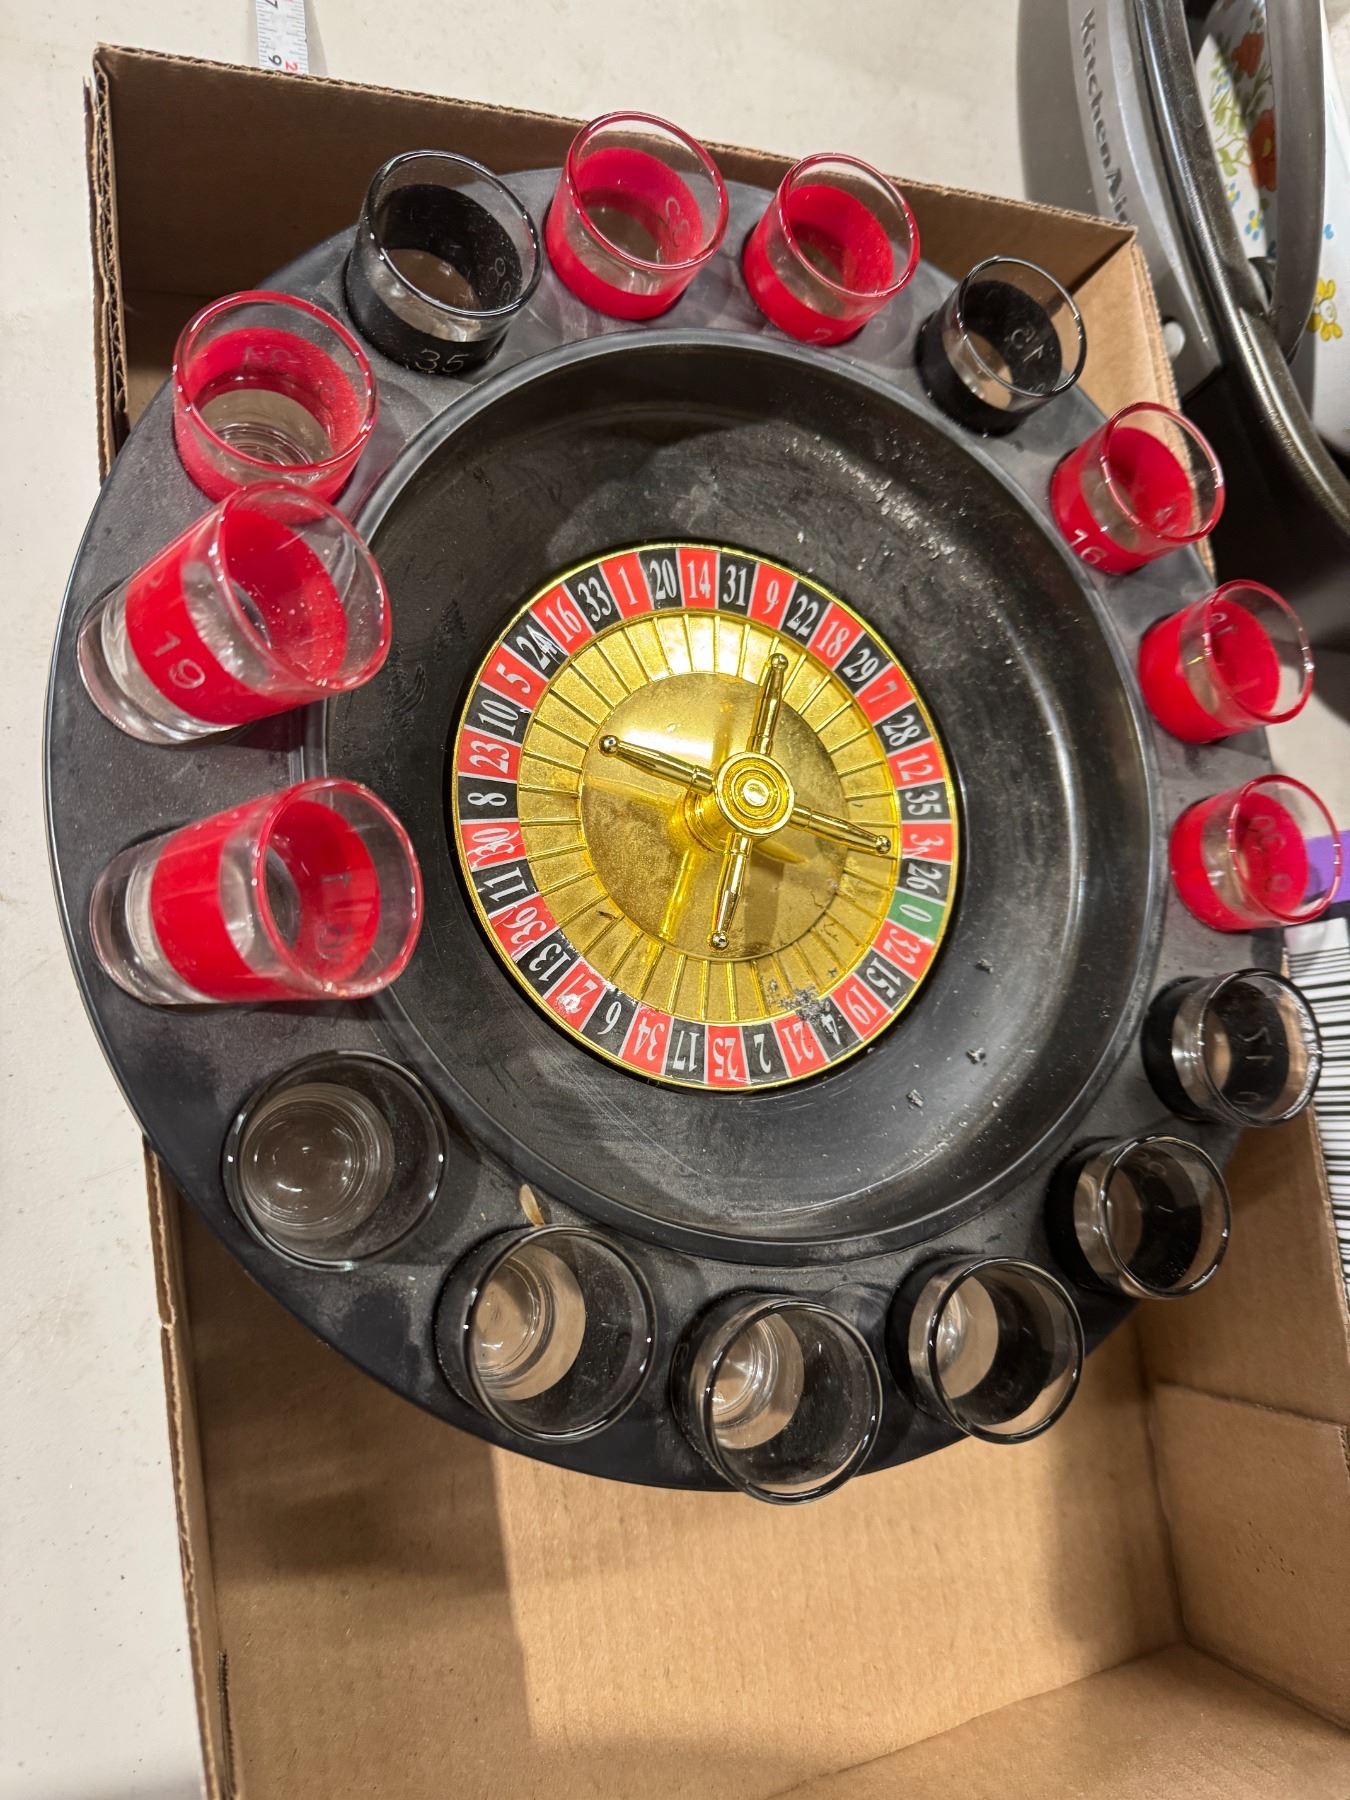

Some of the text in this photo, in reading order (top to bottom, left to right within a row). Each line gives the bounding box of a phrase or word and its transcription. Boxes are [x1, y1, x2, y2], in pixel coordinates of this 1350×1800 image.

[414, 347, 469, 373] 35
[1069, 528, 1108, 564] 16
[618, 566, 639, 605] 1
[650, 559, 677, 600] 20
[687, 560, 710, 599] 14
[723, 564, 747, 607] 31
[762, 579, 780, 615] 9
[578, 576, 613, 622] 33
[786, 594, 820, 637] 22
[545, 597, 582, 644] 16
[816, 620, 850, 658] 18
[152, 631, 206, 689] 19
[516, 623, 561, 671] 24
[842, 648, 879, 683] 29
[495, 662, 531, 694] 5
[867, 680, 898, 704] 7
[478, 700, 518, 736] 10
[882, 714, 920, 747] 28
[469, 740, 509, 774] 23
[896, 753, 934, 782] 12
[467, 792, 507, 807] 8
[905, 790, 942, 816] 35
[483, 867, 529, 902] 11
[906, 862, 943, 894] 26
[502, 906, 547, 945] 36
[899, 903, 932, 923] 0
[529, 943, 571, 982] 13
[883, 928, 921, 965] 32
[865, 957, 901, 998] 15
[597, 1001, 622, 1035] 6
[845, 984, 878, 1025] 19
[633, 1017, 665, 1061] 34
[672, 1030, 699, 1072] 17
[713, 1037, 737, 1077] 25
[754, 1034, 771, 1074] 2
[782, 1023, 814, 1065] 21
